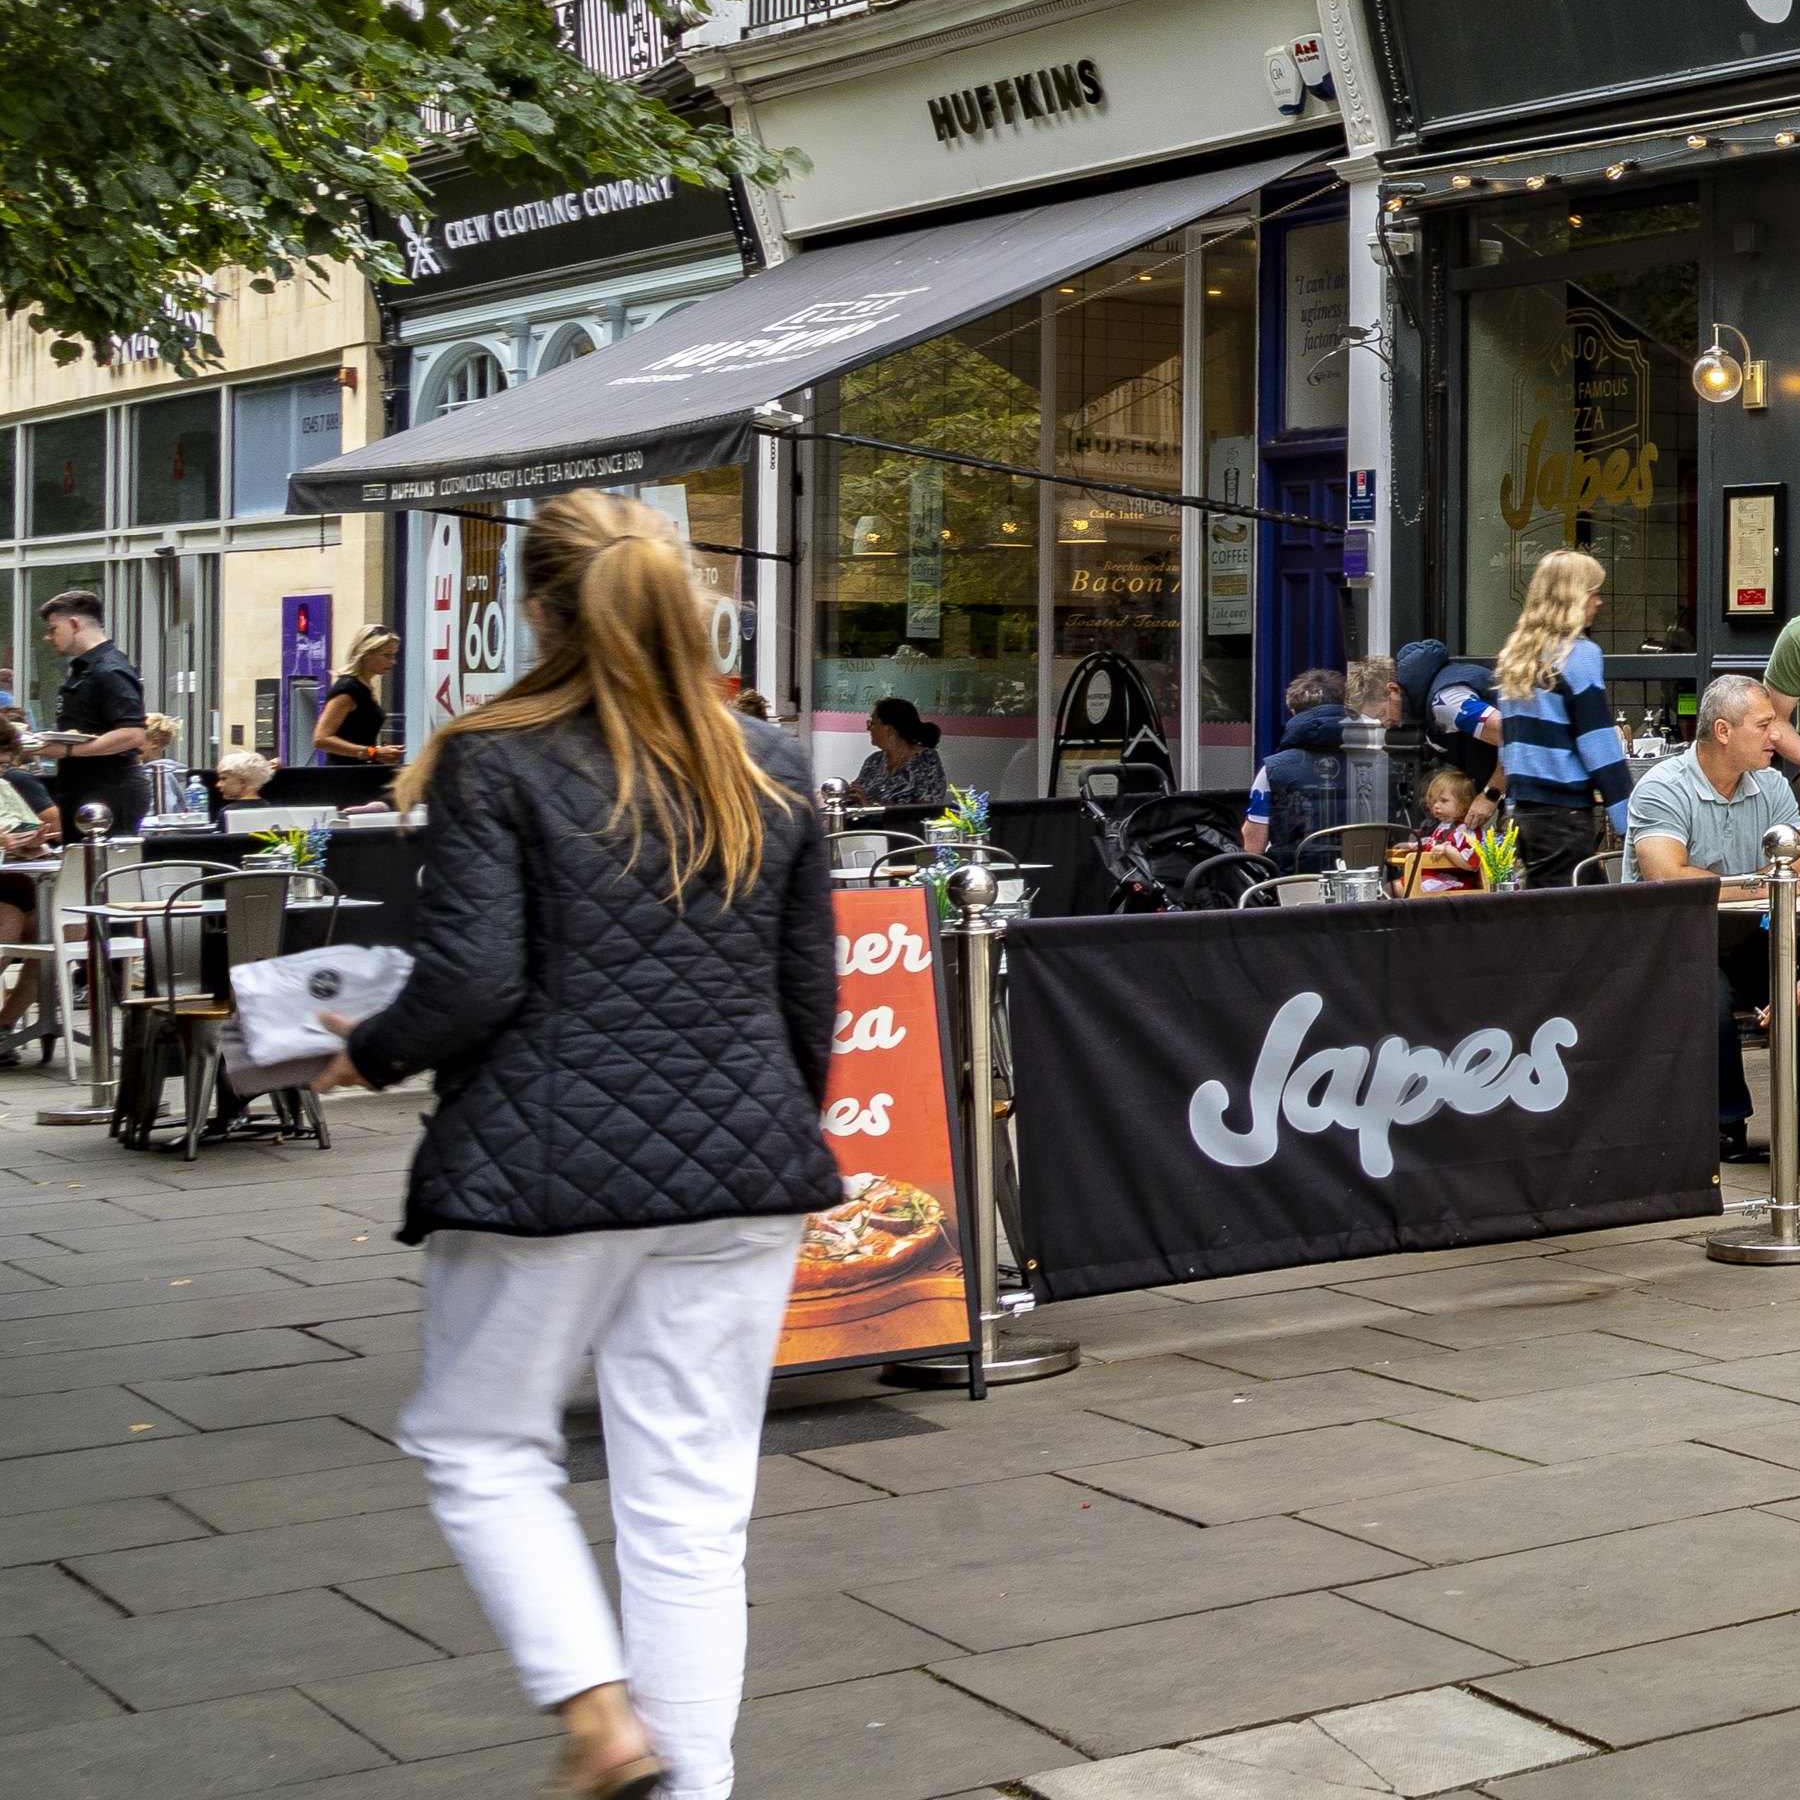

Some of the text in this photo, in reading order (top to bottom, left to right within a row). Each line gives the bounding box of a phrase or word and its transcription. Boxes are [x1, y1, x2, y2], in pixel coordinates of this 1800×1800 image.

[927, 59, 1102, 142] HUFFKINS
[444, 175, 673, 249] CREW CLOTHING COMPANY
[1578, 378, 1629, 399] FAMOUS
[391, 481, 435, 500] HUFFKINS
[546, 464, 562, 483] TEA
[563, 458, 596, 480] ROOMS
[597, 454, 623, 477] SINCE
[1102, 461, 1143, 473] SINCE
[1500, 415, 1658, 545] Japes
[1089, 510, 1144, 519] Cafe latte
[1103, 561, 1165, 573] Beechwood
[1211, 548, 1248, 564] COFFEE
[467, 575, 488, 591] UP TO
[1069, 569, 1163, 593] Bacon
[1064, 614, 1128, 628] Toasted
[465, 601, 504, 670] 60
[1189, 991, 1579, 1178] Japes
